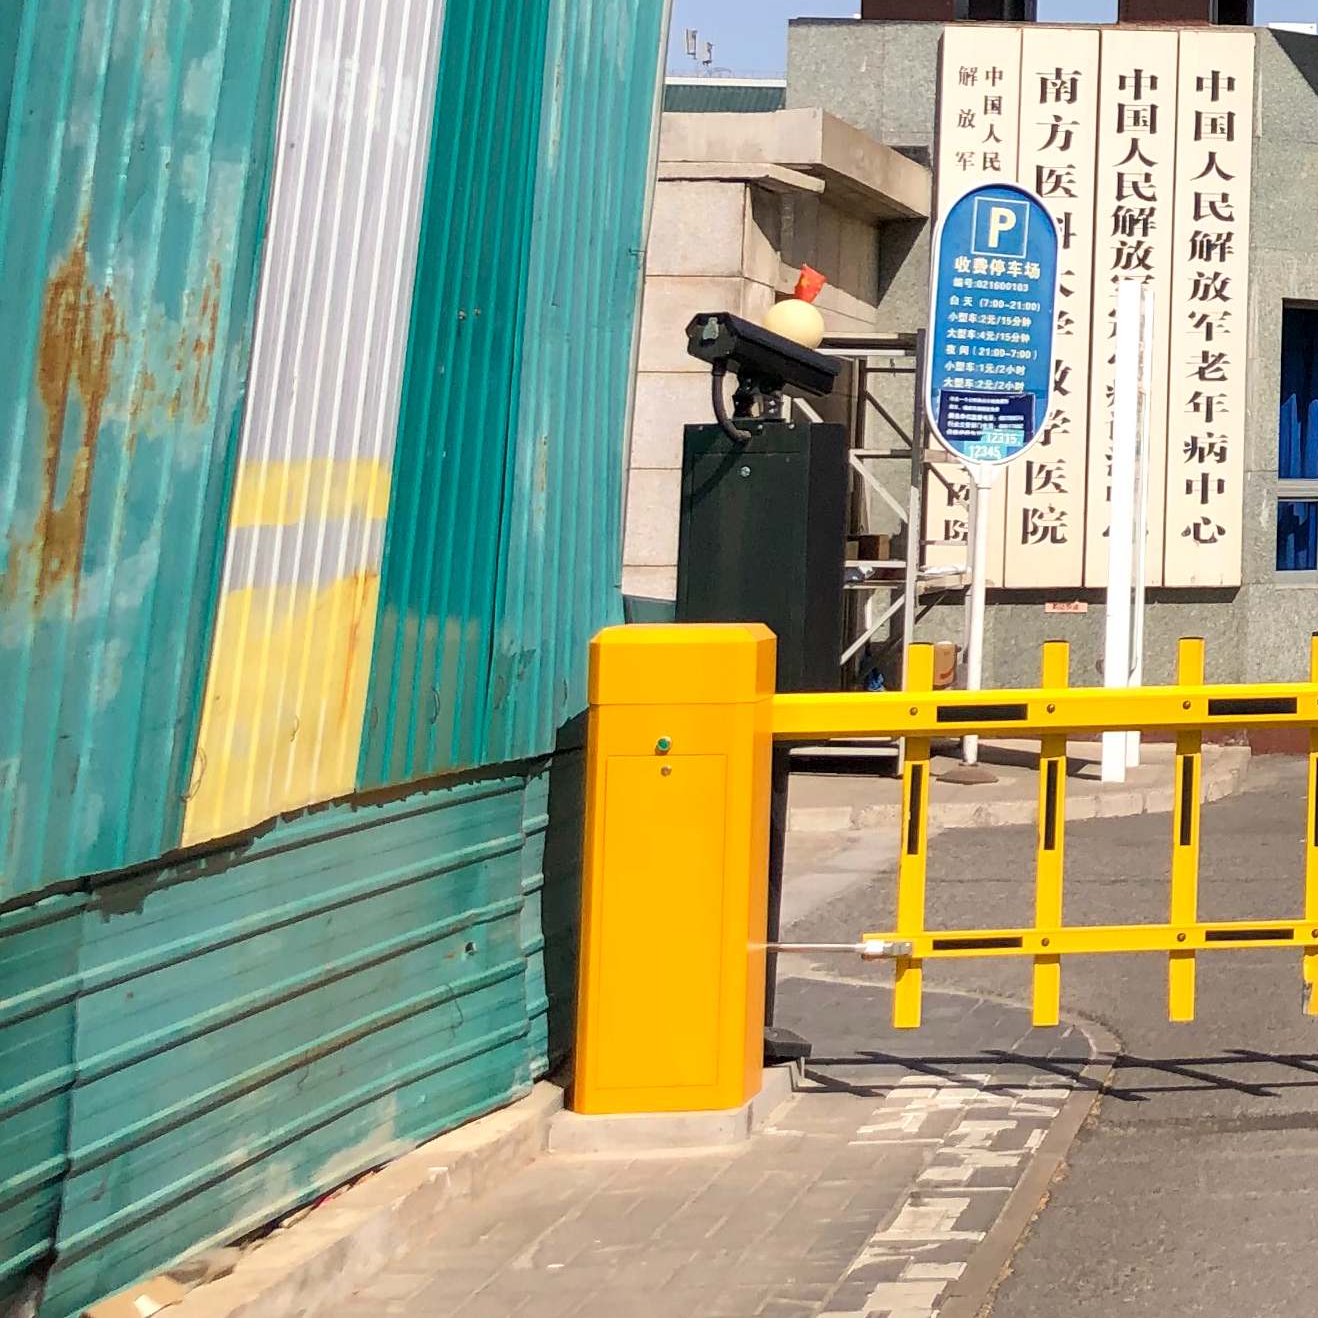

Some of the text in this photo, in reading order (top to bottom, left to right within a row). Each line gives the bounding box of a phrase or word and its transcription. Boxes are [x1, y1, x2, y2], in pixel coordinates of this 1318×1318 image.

[955, 65, 979, 172] 解放军
[982, 66, 1003, 172] 中国人民
[987, 206, 1017, 249] P
[953, 255, 1041, 280] 收费停车场
[1181, 70, 1237, 545] 中国人民解放军老年病中心
[969, 445, 1002, 460] 12345
